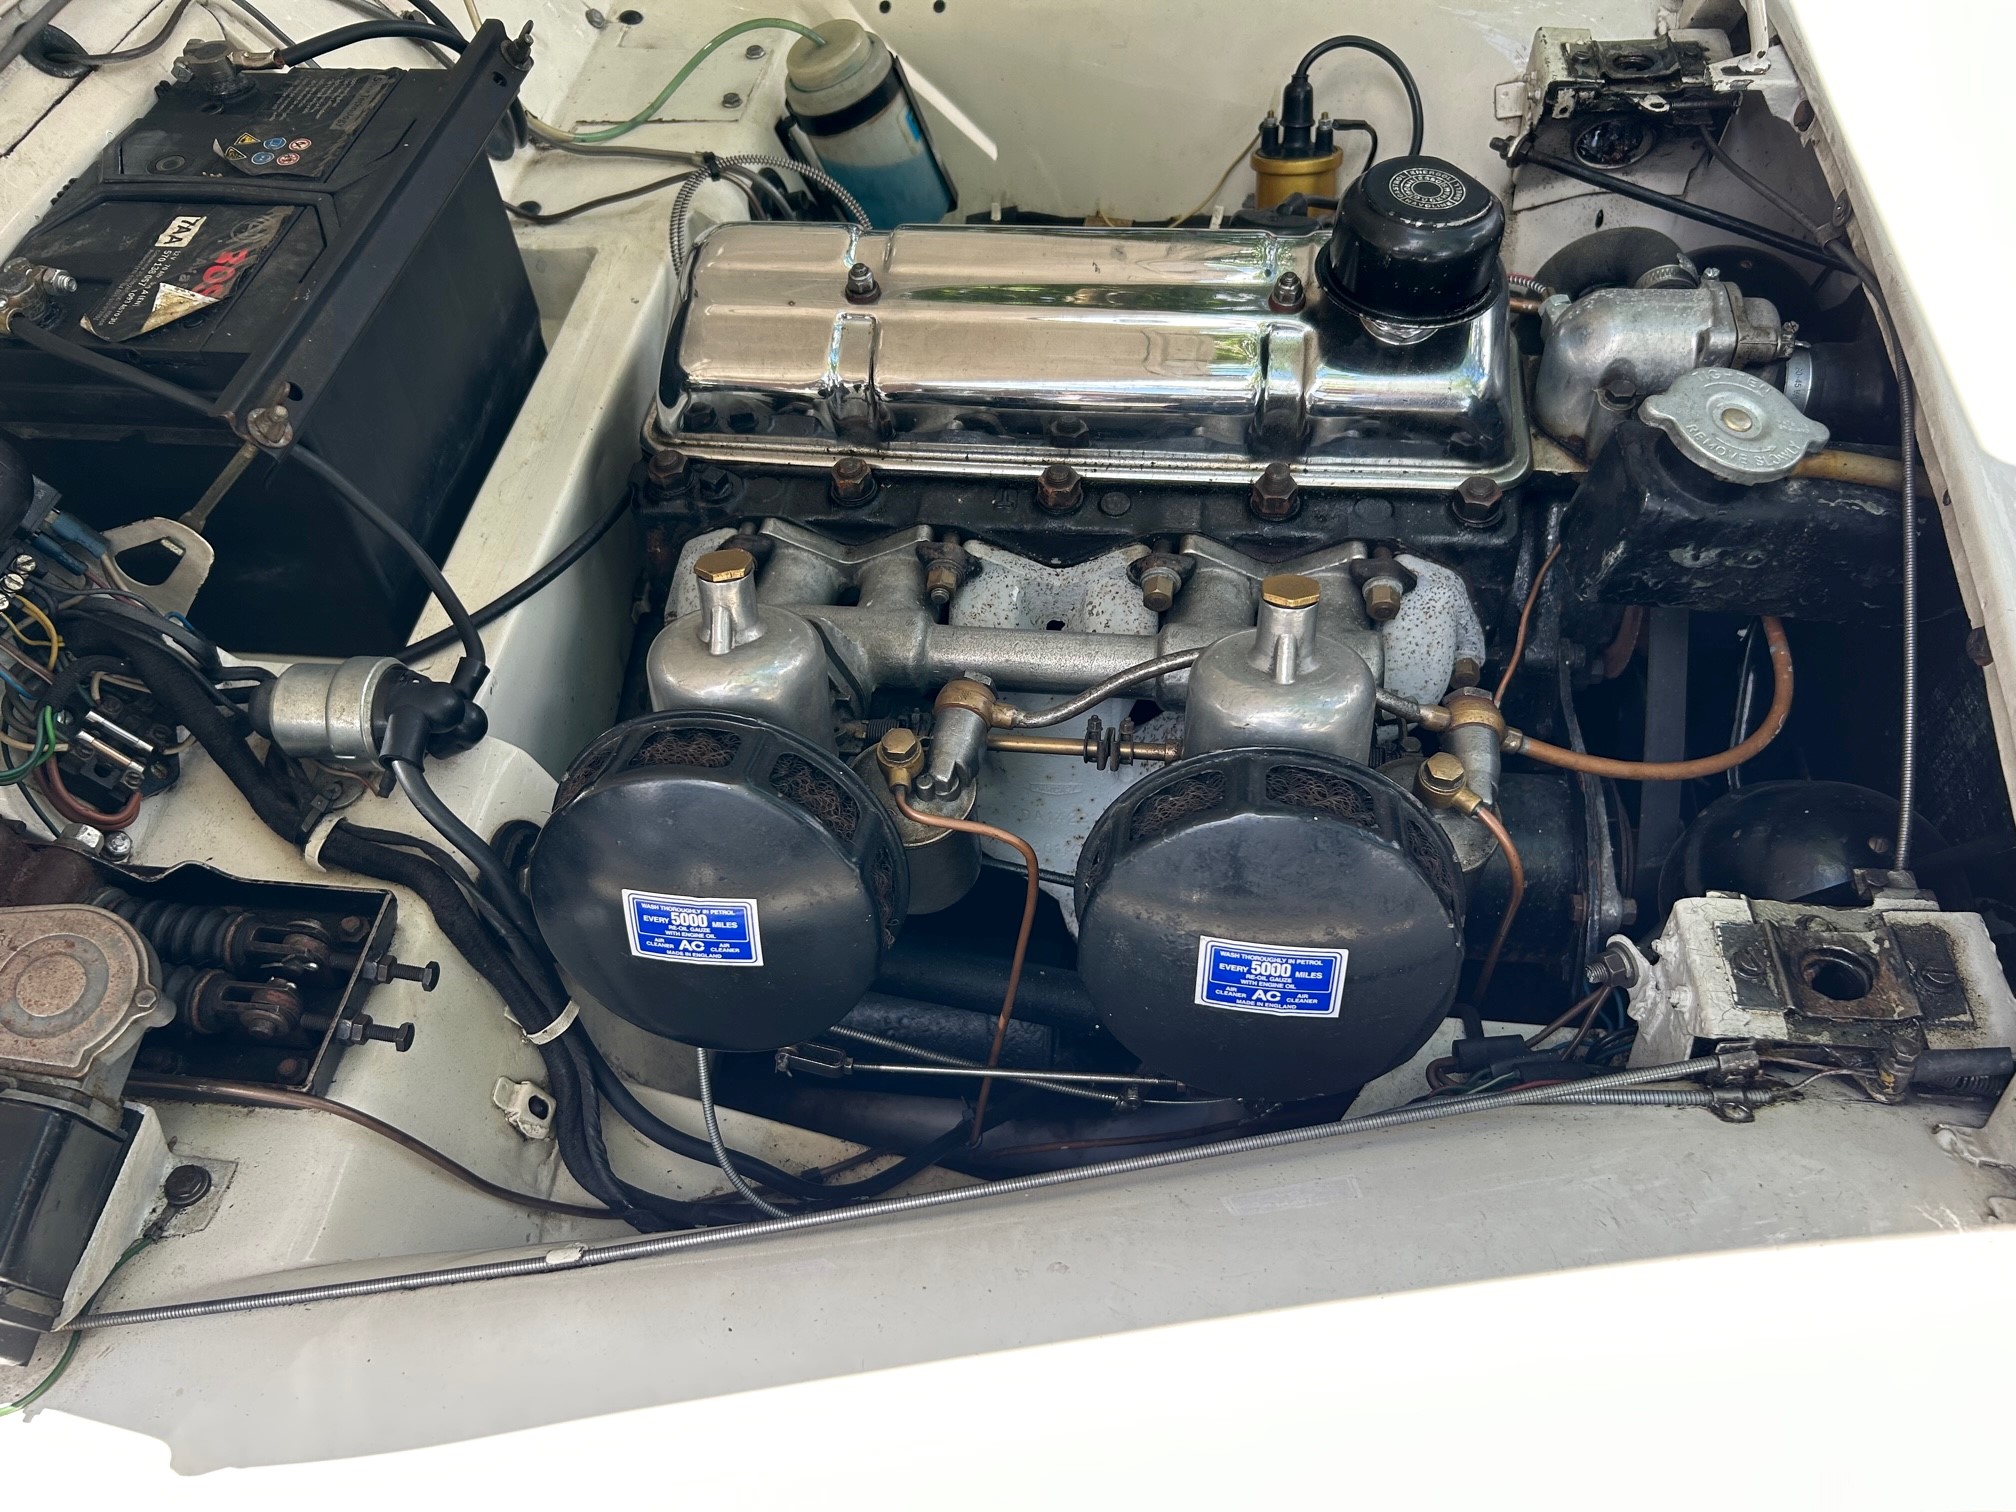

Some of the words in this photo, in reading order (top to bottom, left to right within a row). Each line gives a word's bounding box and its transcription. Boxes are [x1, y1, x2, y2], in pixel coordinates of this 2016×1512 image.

[1409, 170, 1451, 180] ENERGOL
[1392, 174, 1406, 198] CASTROL
[1454, 182, 1462, 200] SHELL
[1692, 369, 1770, 395] TIGHTEN
[1686, 424, 1748, 465] REMOVE
[1754, 440, 1801, 466] SLOWLY
[660, 905, 700, 914] THOROUGHLY
[643, 915, 669, 924] EVERY
[670, 912, 708, 927] 5000
[646, 941, 674, 949] CLEANER
[679, 940, 705, 951] AC
[1241, 953, 1287, 964] THOROUGHLY
[1219, 963, 1248, 973] EVERY
[1250, 961, 1292, 977] 5000
[1295, 971, 1322, 979] MILES
[1245, 973, 1268, 981] RE-OIL
[1215, 989, 1246, 998] CLEANER
[1251, 989, 1281, 1002] AC
